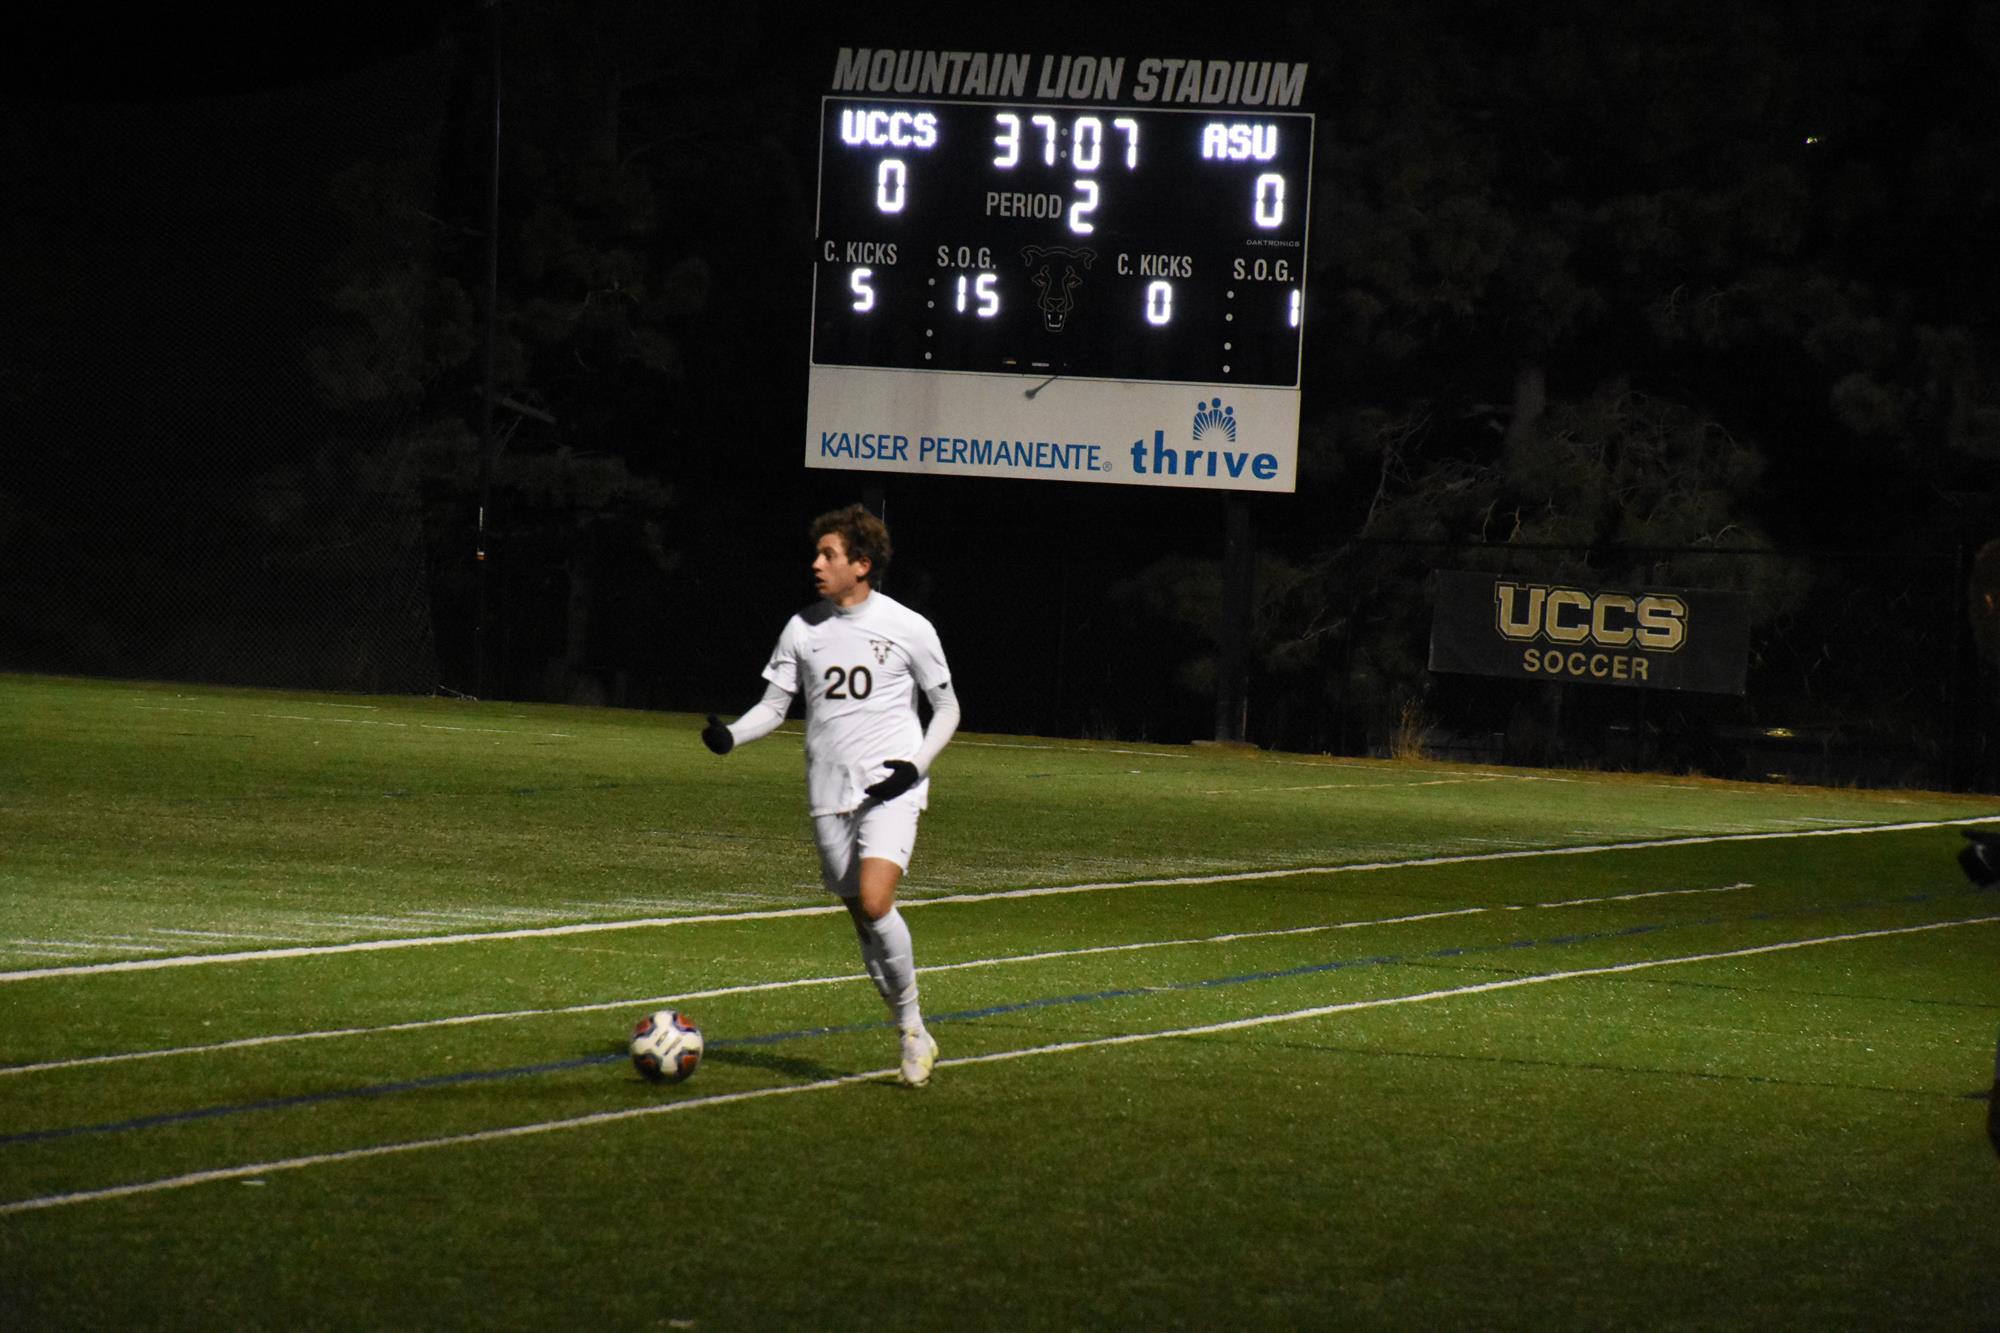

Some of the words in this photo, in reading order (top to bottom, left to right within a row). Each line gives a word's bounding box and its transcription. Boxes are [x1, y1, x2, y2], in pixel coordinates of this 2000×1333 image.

[832, 47, 1031, 98] MOUNTAIN
[1036, 54, 1124, 101] LION
[1132, 57, 1308, 106] STADIUM
[841, 108, 938, 148] UCCS
[992, 113, 1139, 171] 37:07
[1202, 122, 1279, 160] ASU
[877, 159, 906, 213] 0
[986, 191, 1063, 219] PERIOD
[1254, 173, 1285, 227] 0
[1068, 180, 1099, 234] 2
[824, 240, 842, 262] C.
[846, 242, 898, 265] KICKS
[937, 246, 997, 269] S.O.G.
[1246, 239, 1300, 248] DAKTRONICS
[1117, 254, 1136, 276] C.
[1140, 255, 1193, 278] KICKS
[1233, 257, 1295, 281] S.O.G.
[850, 268, 874, 312] 5
[956, 274, 1000, 317] 15
[1146, 280, 1172, 325] 0
[821, 430, 909, 462] KAISER
[919, 435, 1102, 471] PERMANENTE
[1130, 429, 1279, 480] thrive
[1495, 581, 1688, 651] UCCS
[824, 665, 872, 700] 20
[1522, 648, 1650, 680] SOCCER
